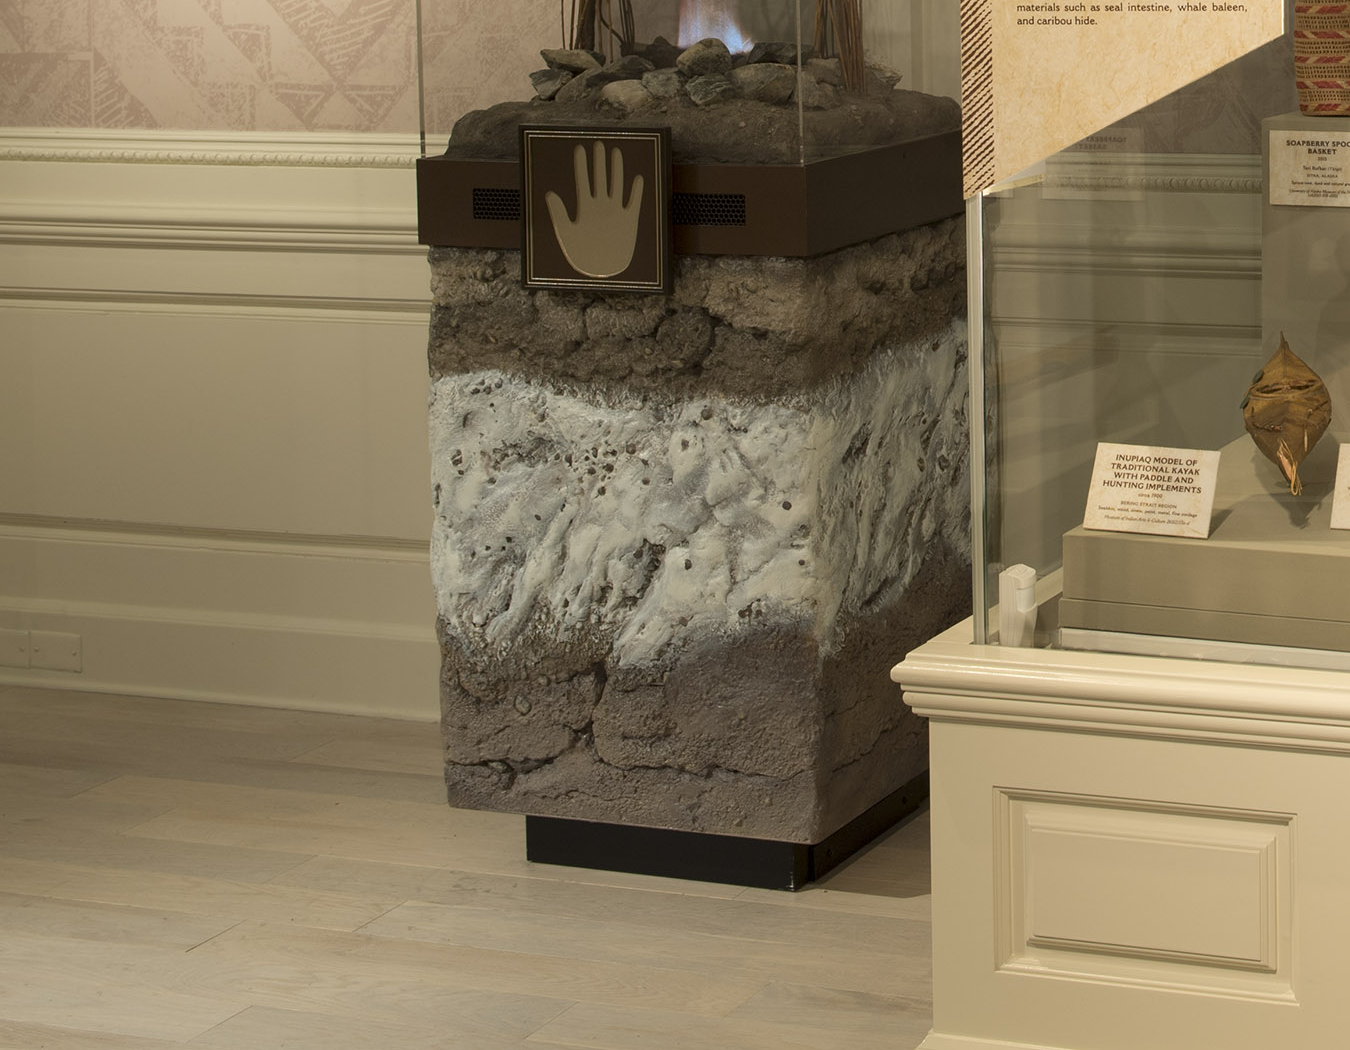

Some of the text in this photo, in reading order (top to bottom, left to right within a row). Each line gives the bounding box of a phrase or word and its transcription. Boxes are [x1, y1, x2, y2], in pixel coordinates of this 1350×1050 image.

[1116, 454, 1152, 464] INUPIAQ
[1153, 457, 1184, 466] MODEL
[1111, 463, 1200, 476] TRADITIONAL KAYAK
[1114, 472, 1194, 484] WITH PADDLE AND
[1102, 480, 1202, 494] HUNTING IMPLEMENTS
